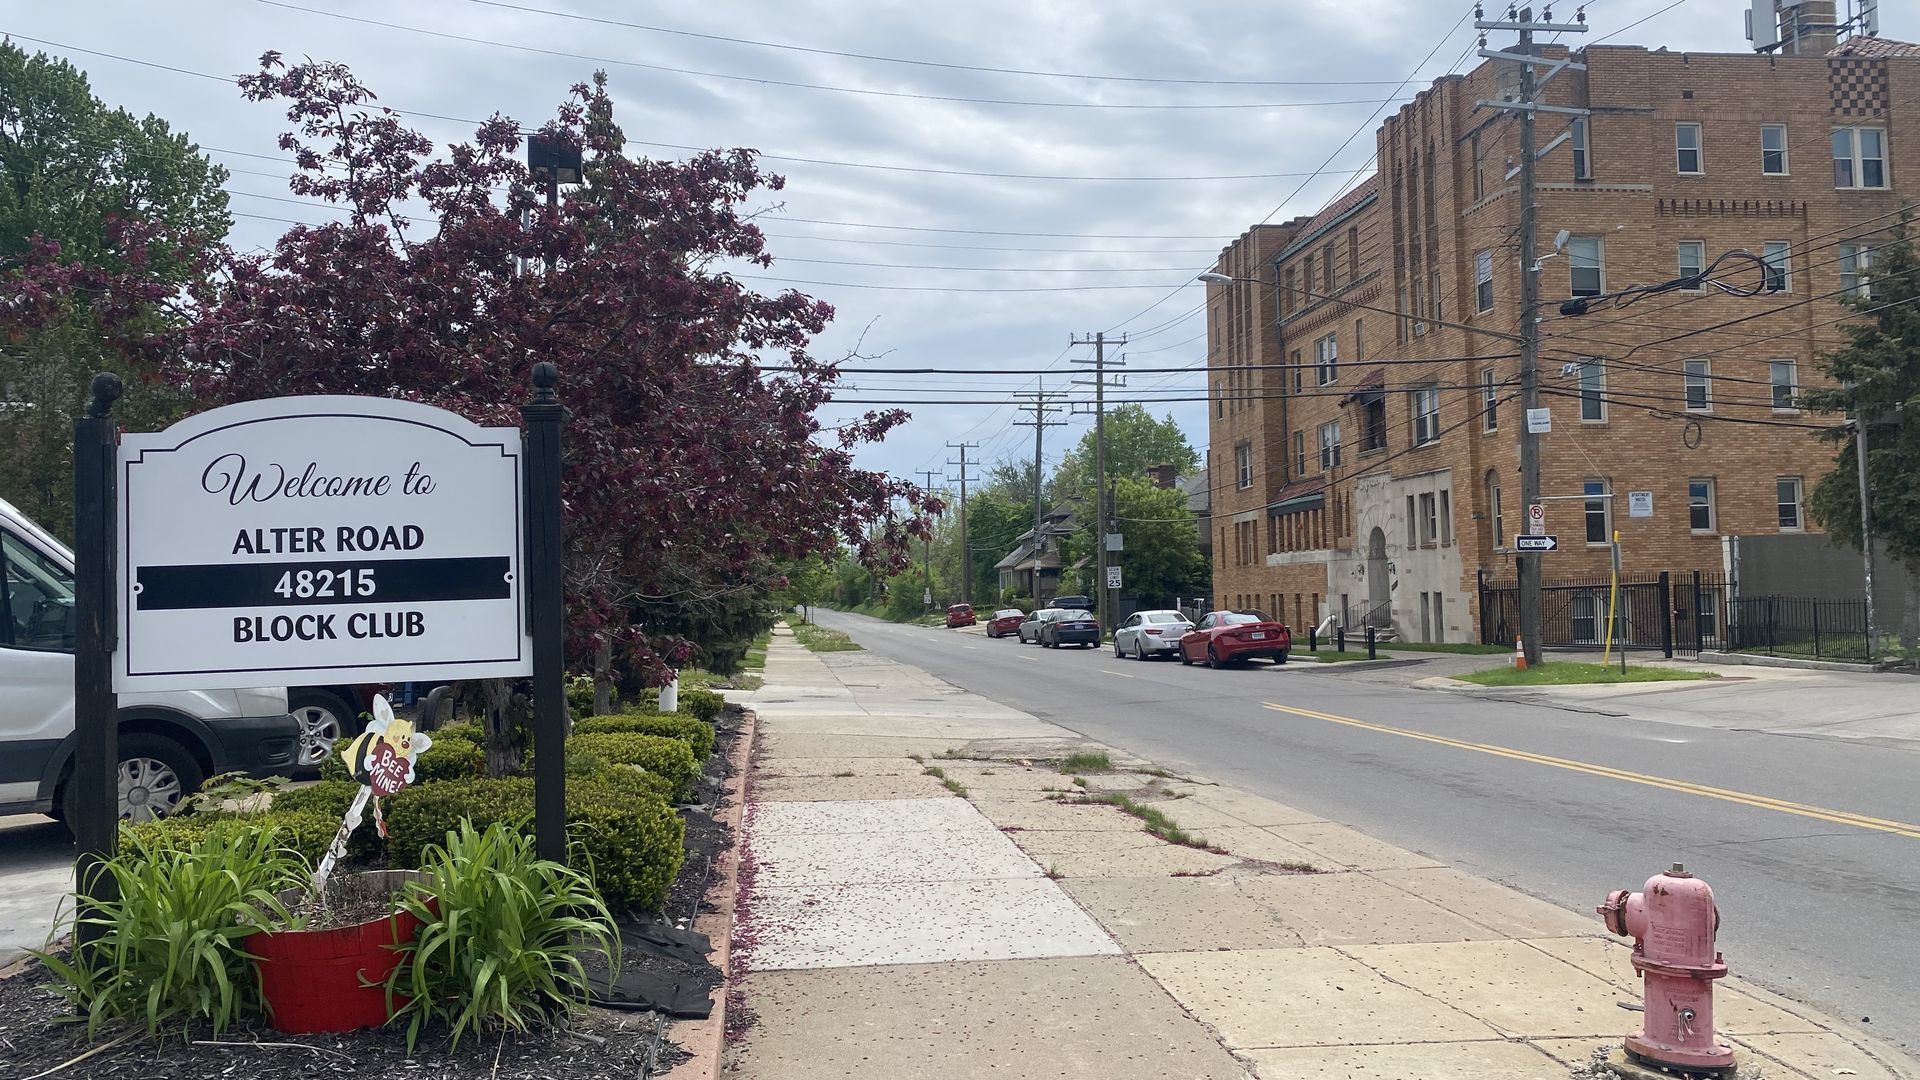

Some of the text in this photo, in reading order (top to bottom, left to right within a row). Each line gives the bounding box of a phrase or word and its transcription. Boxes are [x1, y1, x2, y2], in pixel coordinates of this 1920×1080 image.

[201, 453, 437, 506] Welcome to
[232, 524, 425, 554] ALTER ROAD
[273, 568, 376, 599] 48215
[1109, 579, 1121, 587] 25
[233, 611, 425, 643] BLOCK CLUB
[370, 762, 402, 794] MINE!
[381, 749, 404, 778] BEE
